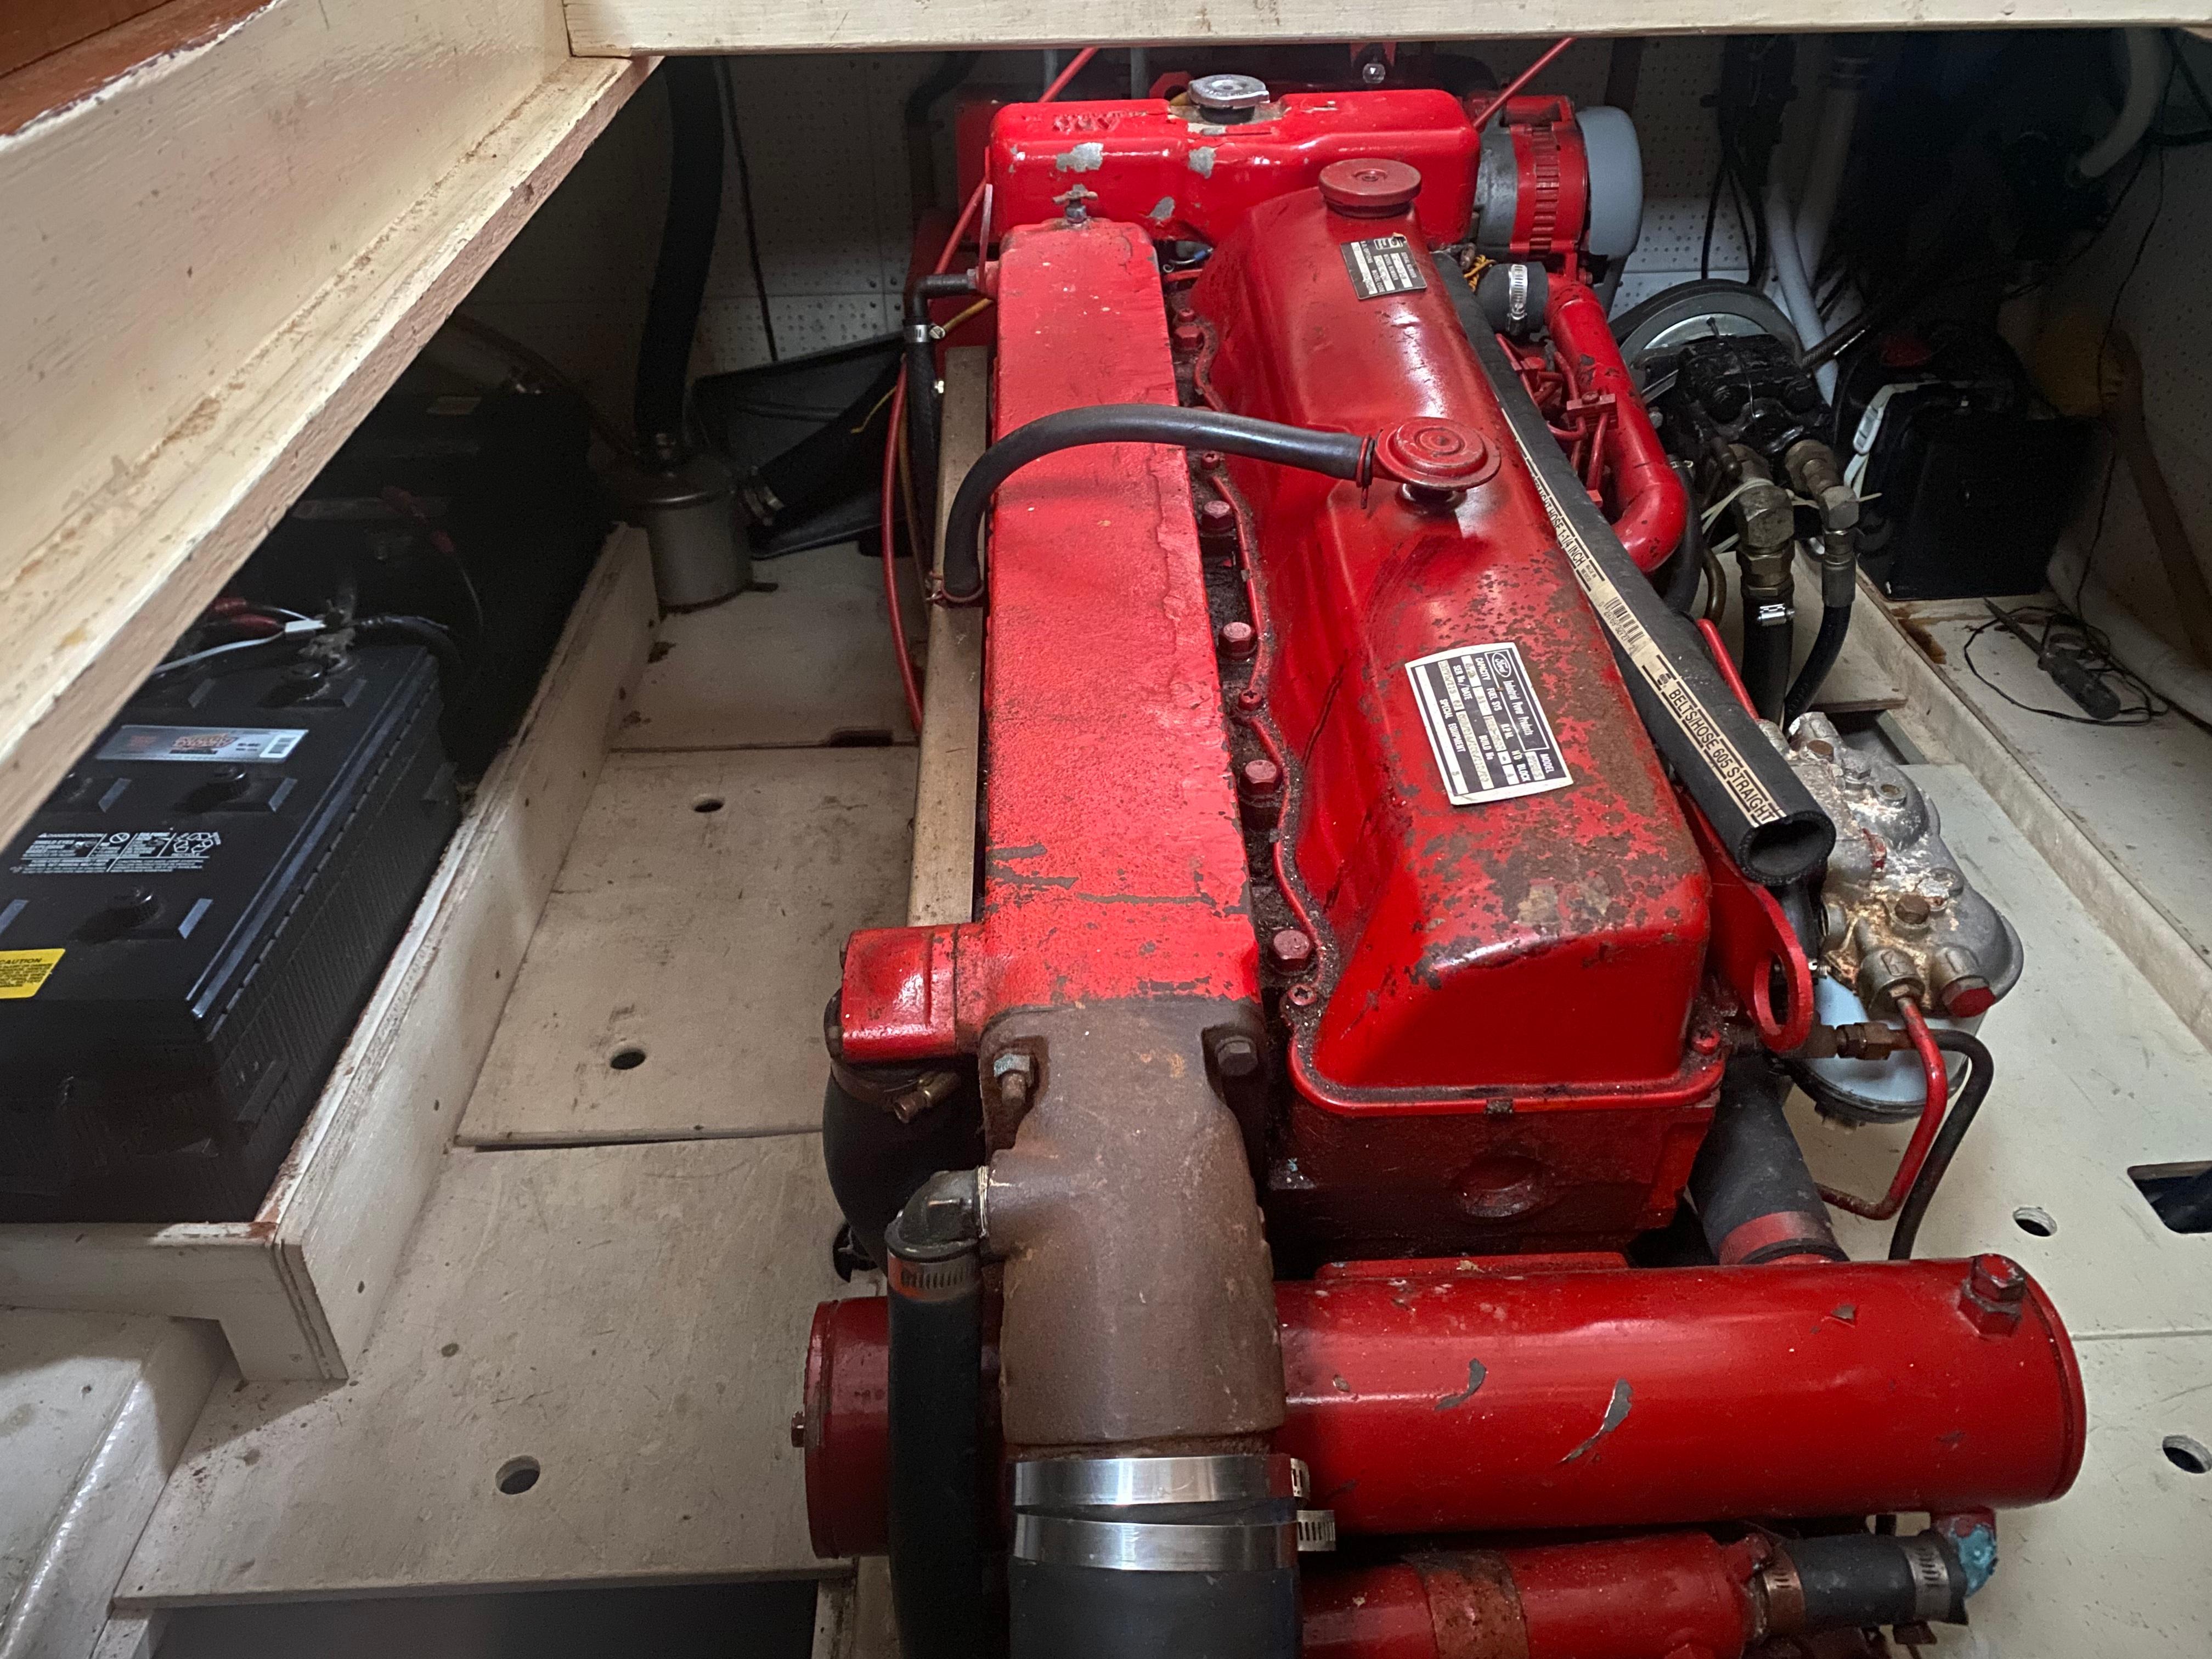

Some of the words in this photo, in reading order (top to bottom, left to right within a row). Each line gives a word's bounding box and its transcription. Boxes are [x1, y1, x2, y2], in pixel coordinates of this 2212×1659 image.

[1547, 508, 1564, 531] HOSE
[1558, 528, 1574, 548] 1-1/4
[1567, 544, 1587, 566] INCH
[1580, 568, 1592, 582] MEXICO
[1452, 664, 1463, 675] SER
[1474, 657, 1491, 681] CAPACITY
[1486, 687, 1498, 699] FUEL
[1503, 680, 1520, 700] Industrial
[1491, 701, 1502, 711] SYS
[1511, 701, 1526, 715] Power
[1439, 698, 1453, 719] SPECIAL
[1447, 723, 1466, 753] EQUIPMENT
[1517, 716, 1535, 735] Products
[1478, 735, 1492, 751] BUILD
[1485, 752, 1496, 760] No
[1668, 687, 1719, 751] BELTS/HOSE
[1711, 746, 1733, 770] 605
[1726, 765, 1775, 826] STRAIGHT
[1516, 763, 1531, 781] BLOCK
[1538, 753, 1555, 773] MODEL
